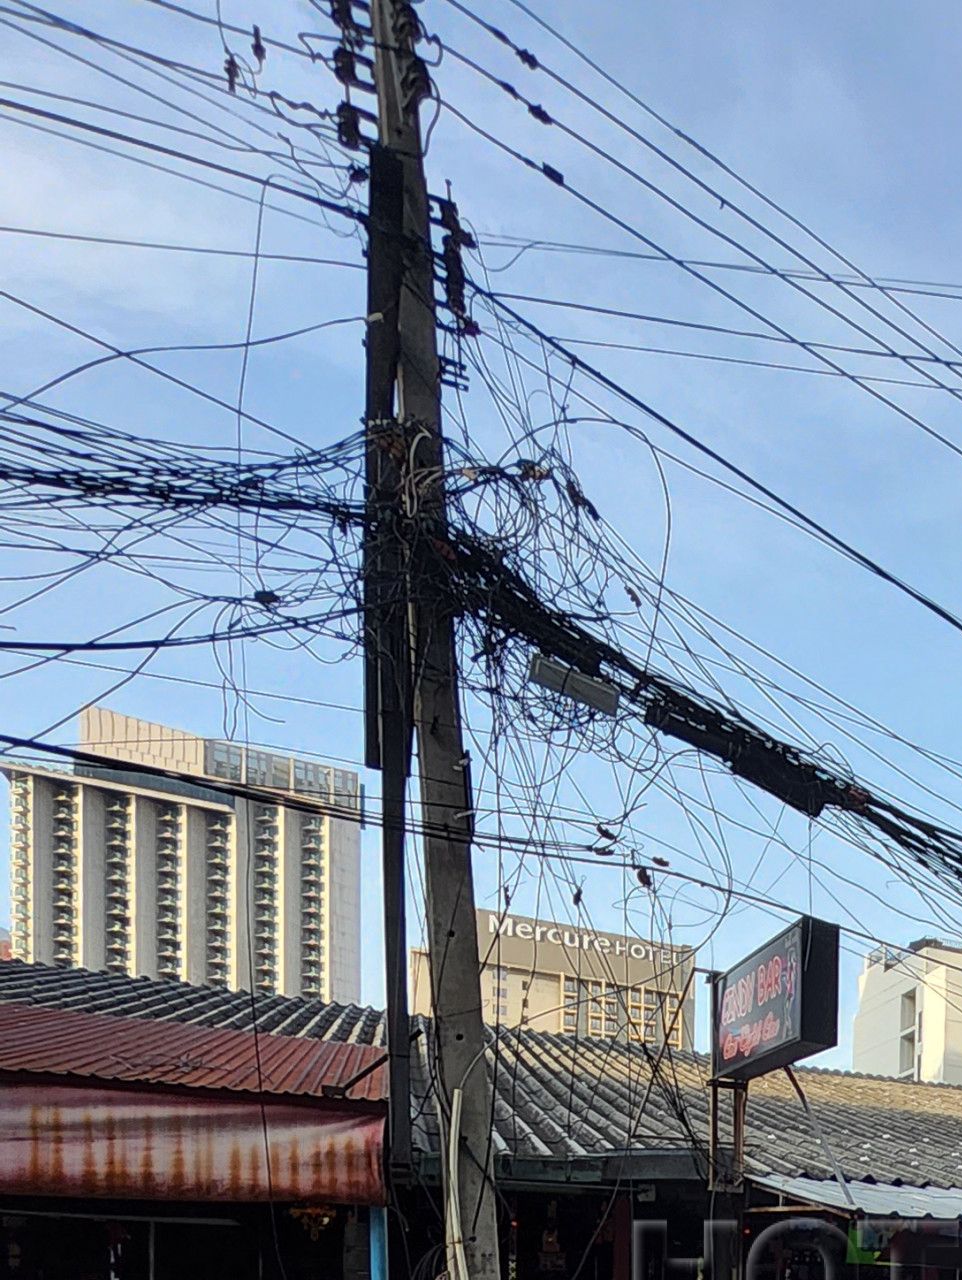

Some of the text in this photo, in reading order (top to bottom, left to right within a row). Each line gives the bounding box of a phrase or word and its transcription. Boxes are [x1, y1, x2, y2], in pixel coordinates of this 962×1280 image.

[488, 914, 682, 965] Mercure HOTEL
[757, 955, 782, 1006] BAR
